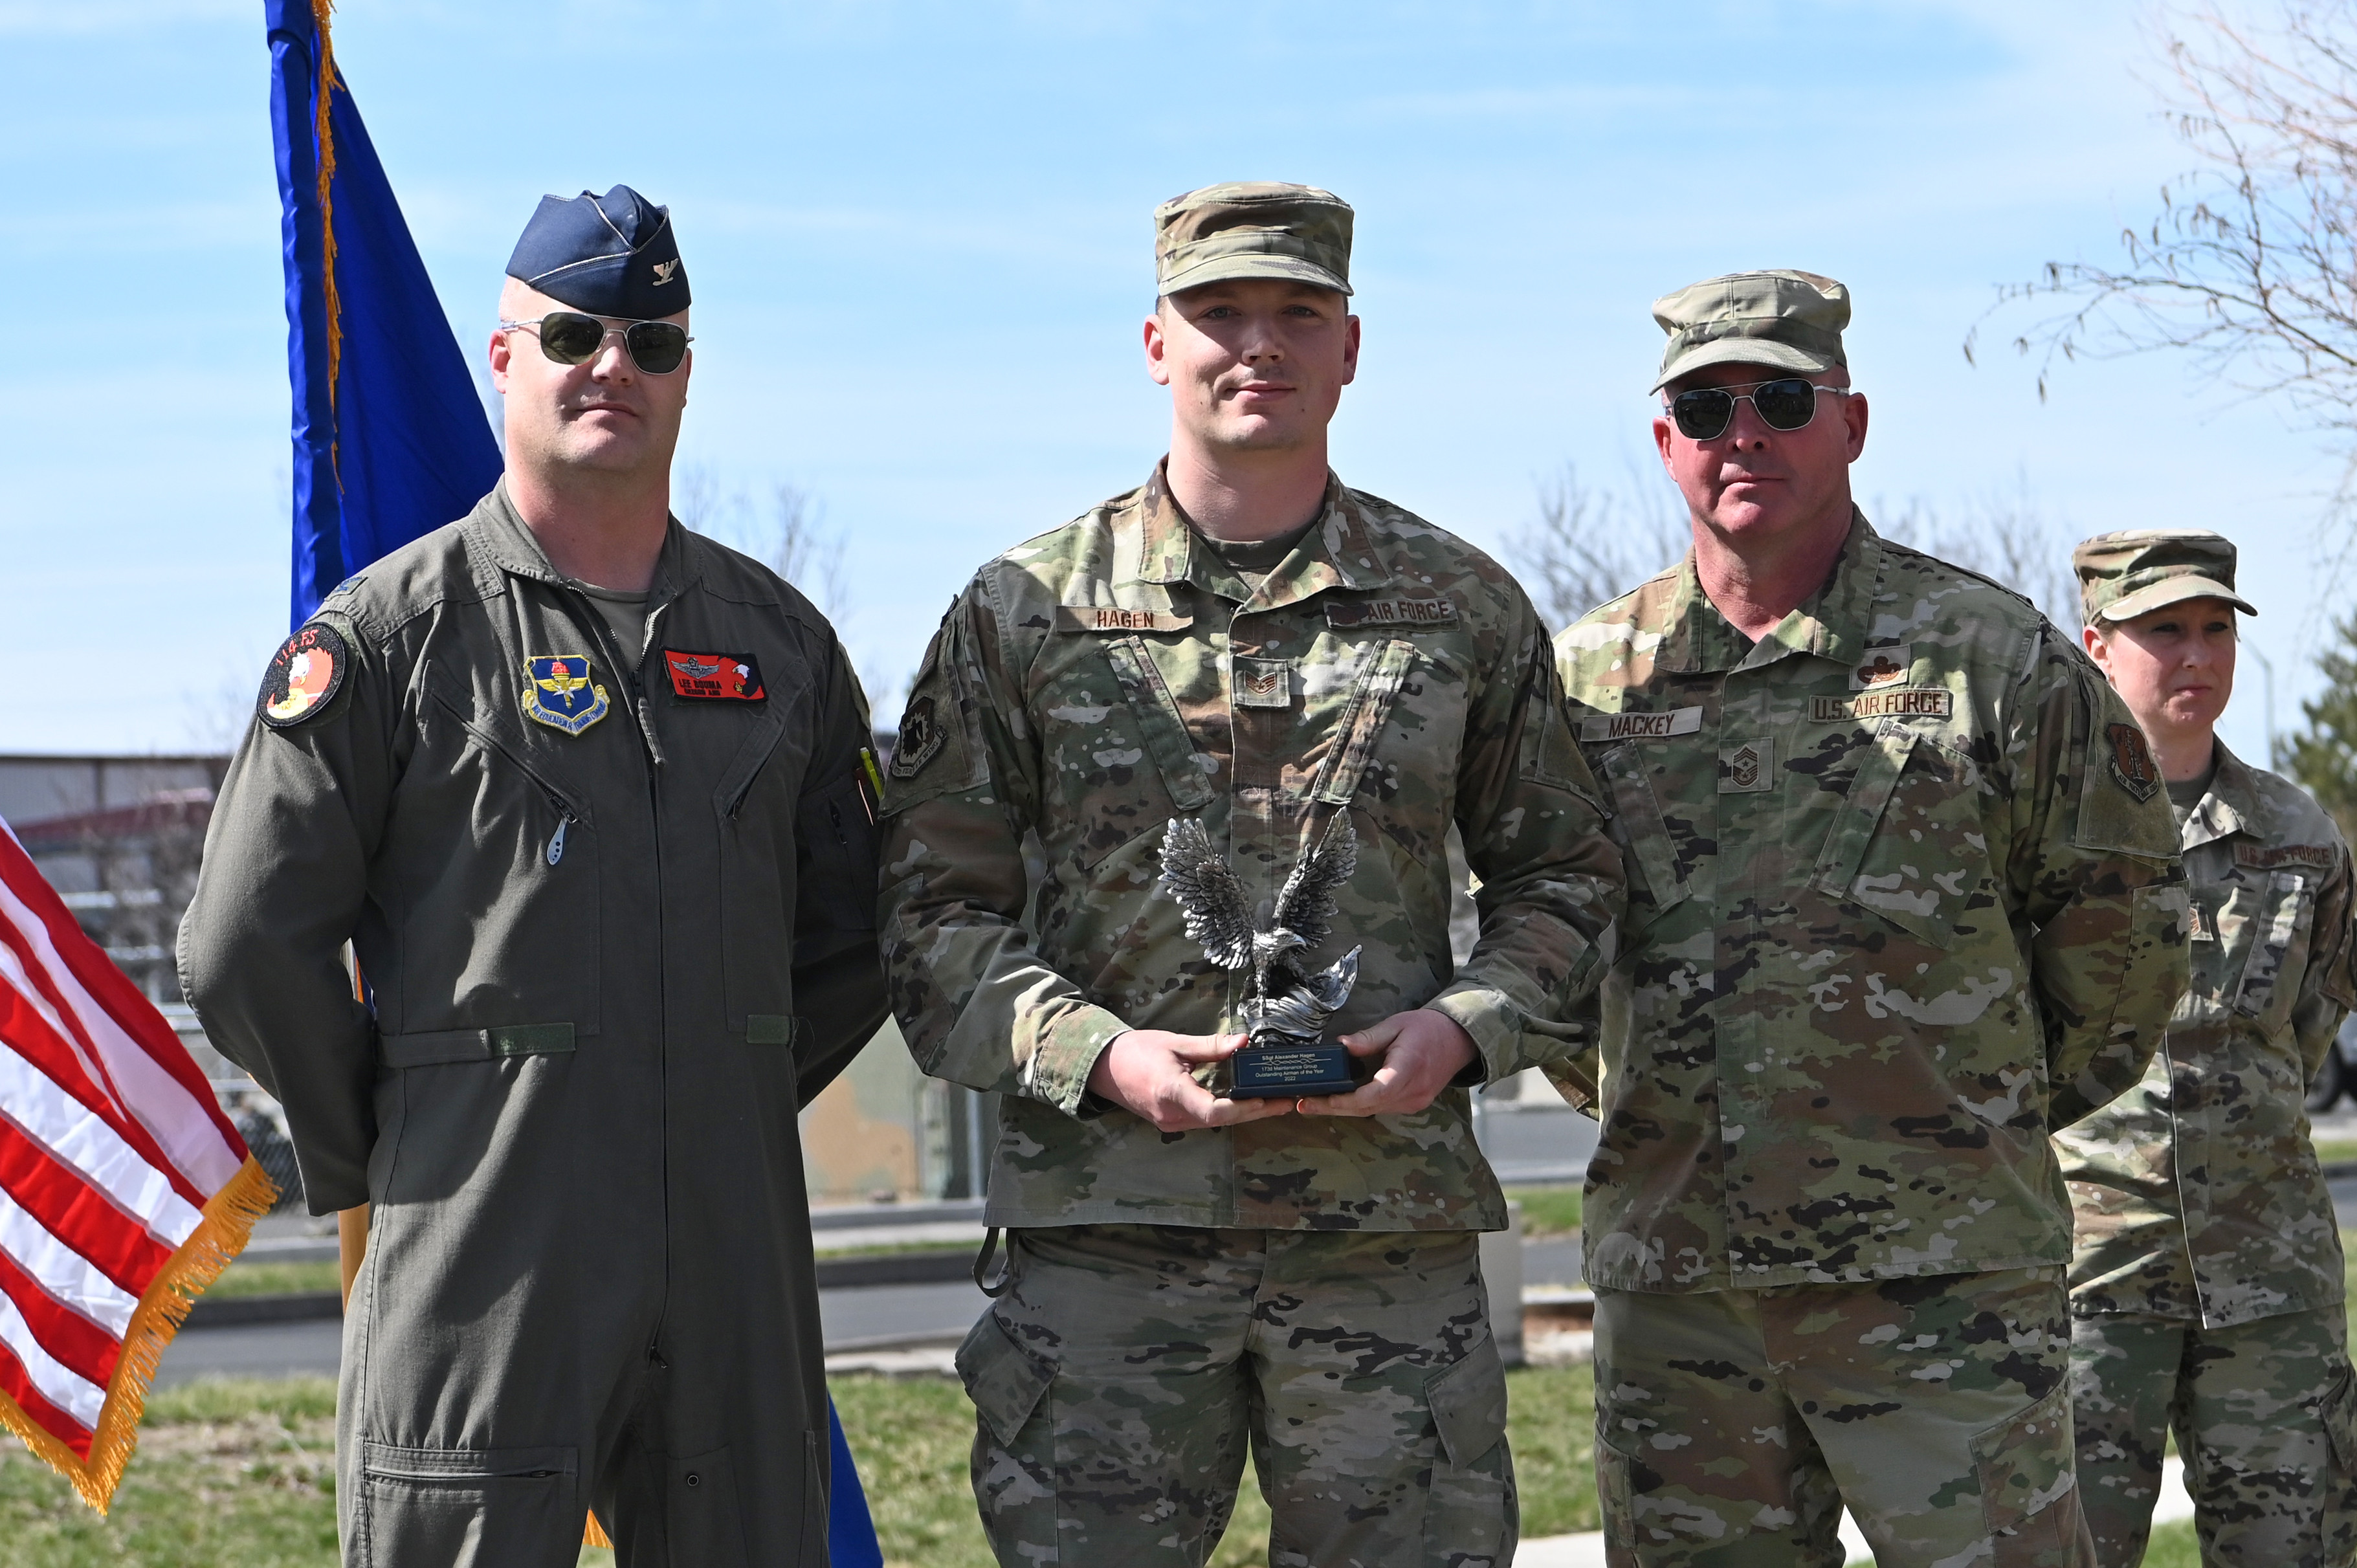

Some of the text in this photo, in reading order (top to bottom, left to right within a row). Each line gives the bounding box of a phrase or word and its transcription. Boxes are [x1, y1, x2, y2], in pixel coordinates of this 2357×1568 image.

[1097, 610, 1154, 628] HAGEN
[1367, 603, 1395, 621] AIR
[1397, 601, 1450, 621] FORCE
[276, 629, 319, 666] 114 FS
[678, 678, 692, 688] LEE
[1815, 692, 1942, 720] U.S. AIR FORCE
[531, 705, 541, 716] AIR
[568, 722, 573, 731] &
[1609, 714, 1675, 738] MACKEY
[923, 741, 938, 758] WING
[2118, 774, 2127, 785] AIR
[2289, 845, 2330, 864] FORCE
